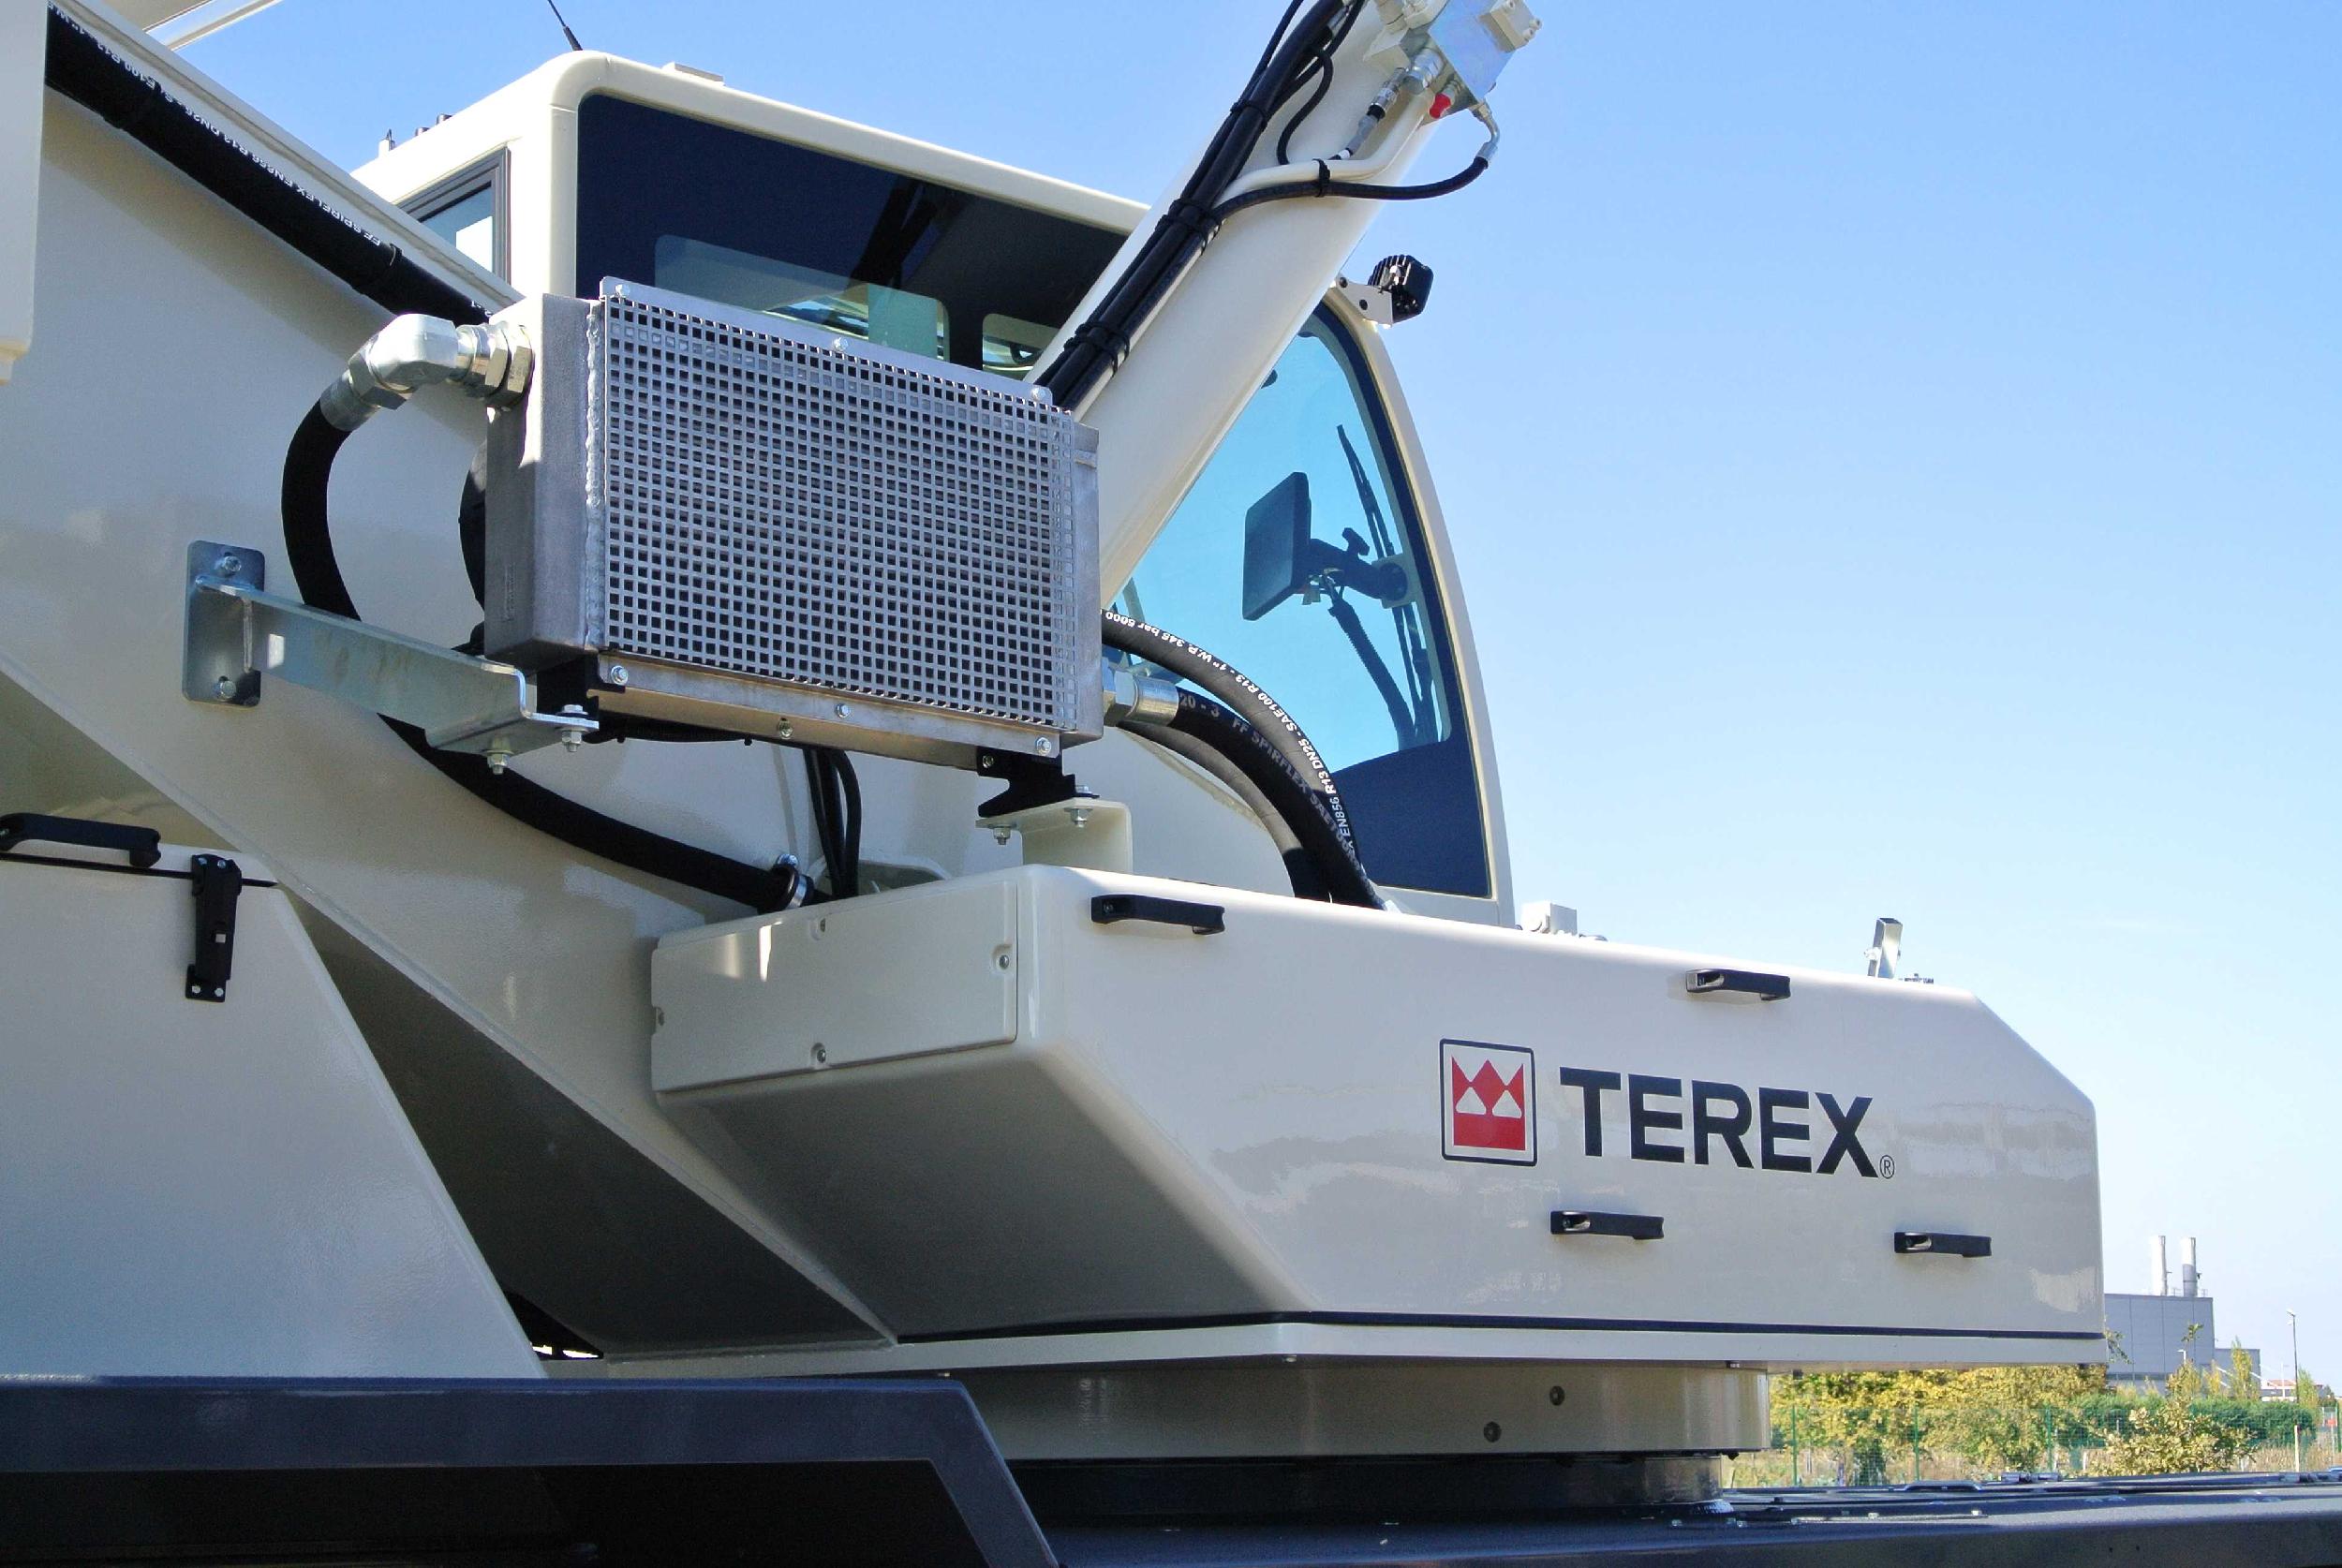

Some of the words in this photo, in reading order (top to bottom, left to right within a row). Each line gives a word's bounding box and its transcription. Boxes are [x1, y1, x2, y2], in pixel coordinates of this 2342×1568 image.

[1105, 611, 1135, 629] 5000
[1137, 622, 1161, 637] bar
[1236, 674, 1259, 693] R13
[1257, 692, 1297, 732] SAE100
[1252, 731, 1308, 793] SPIRFLEX
[1298, 738, 1324, 770] DN25
[1318, 770, 1337, 794] R13
[1329, 796, 1352, 837] EN856
